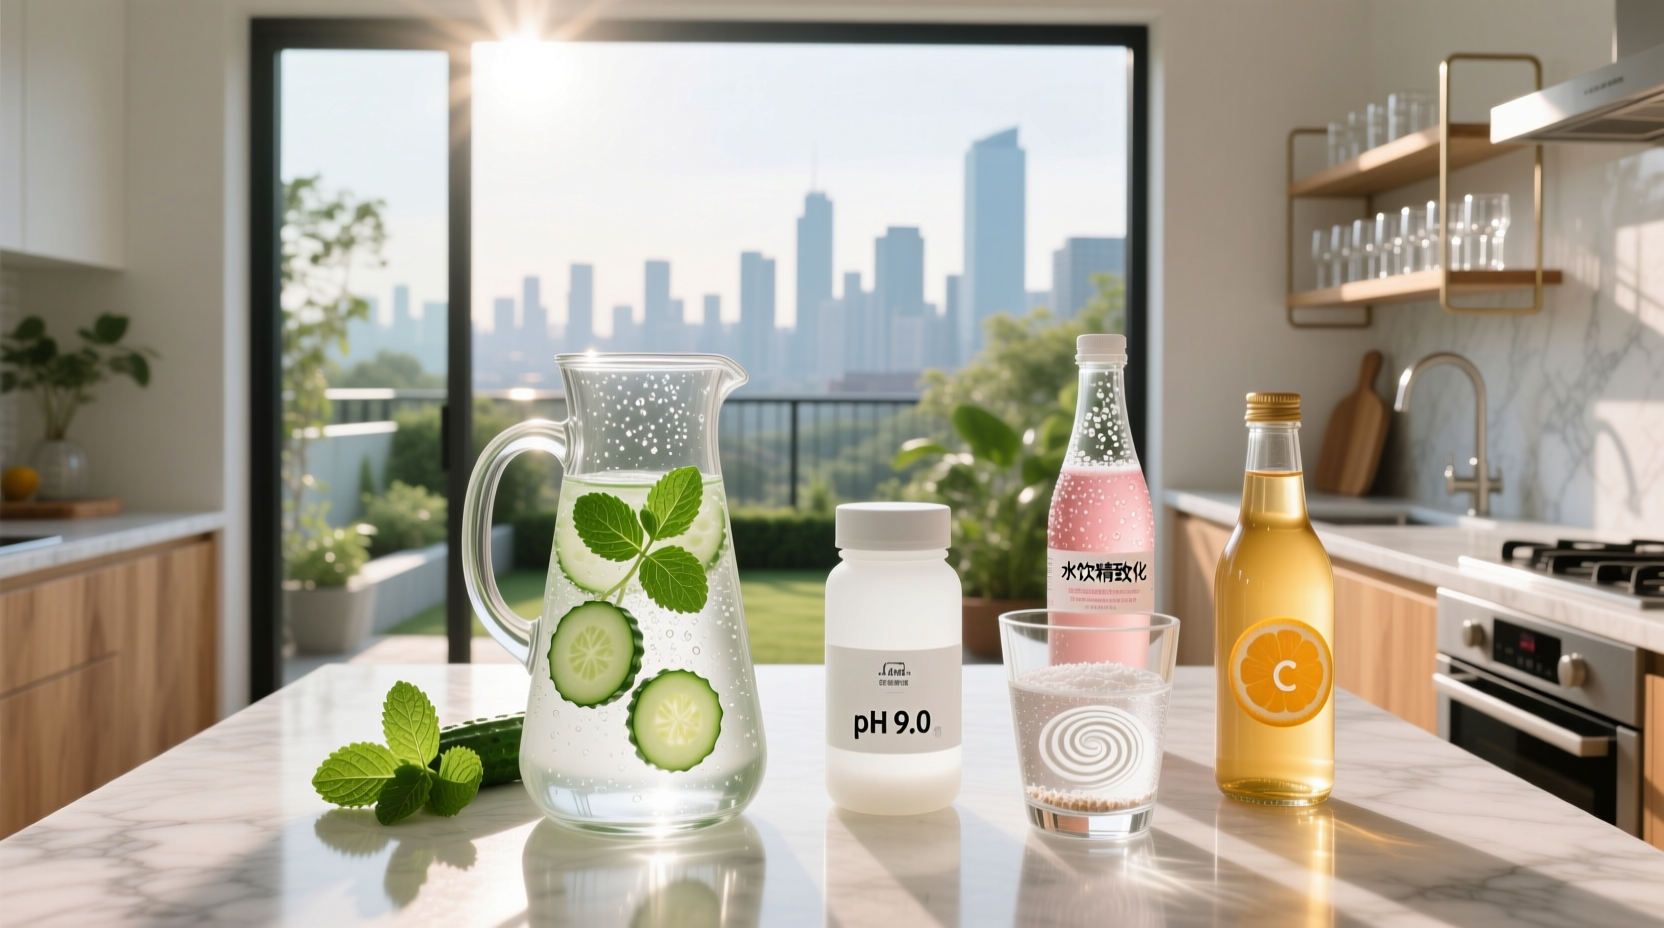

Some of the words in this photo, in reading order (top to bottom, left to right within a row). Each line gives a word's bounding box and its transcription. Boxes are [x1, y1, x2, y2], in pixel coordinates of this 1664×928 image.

[1061, 561, 1147, 583] 水饮精致化
[1273, 659, 1297, 692] C
[854, 710, 887, 739] pH
[893, 709, 931, 734] 9.0
